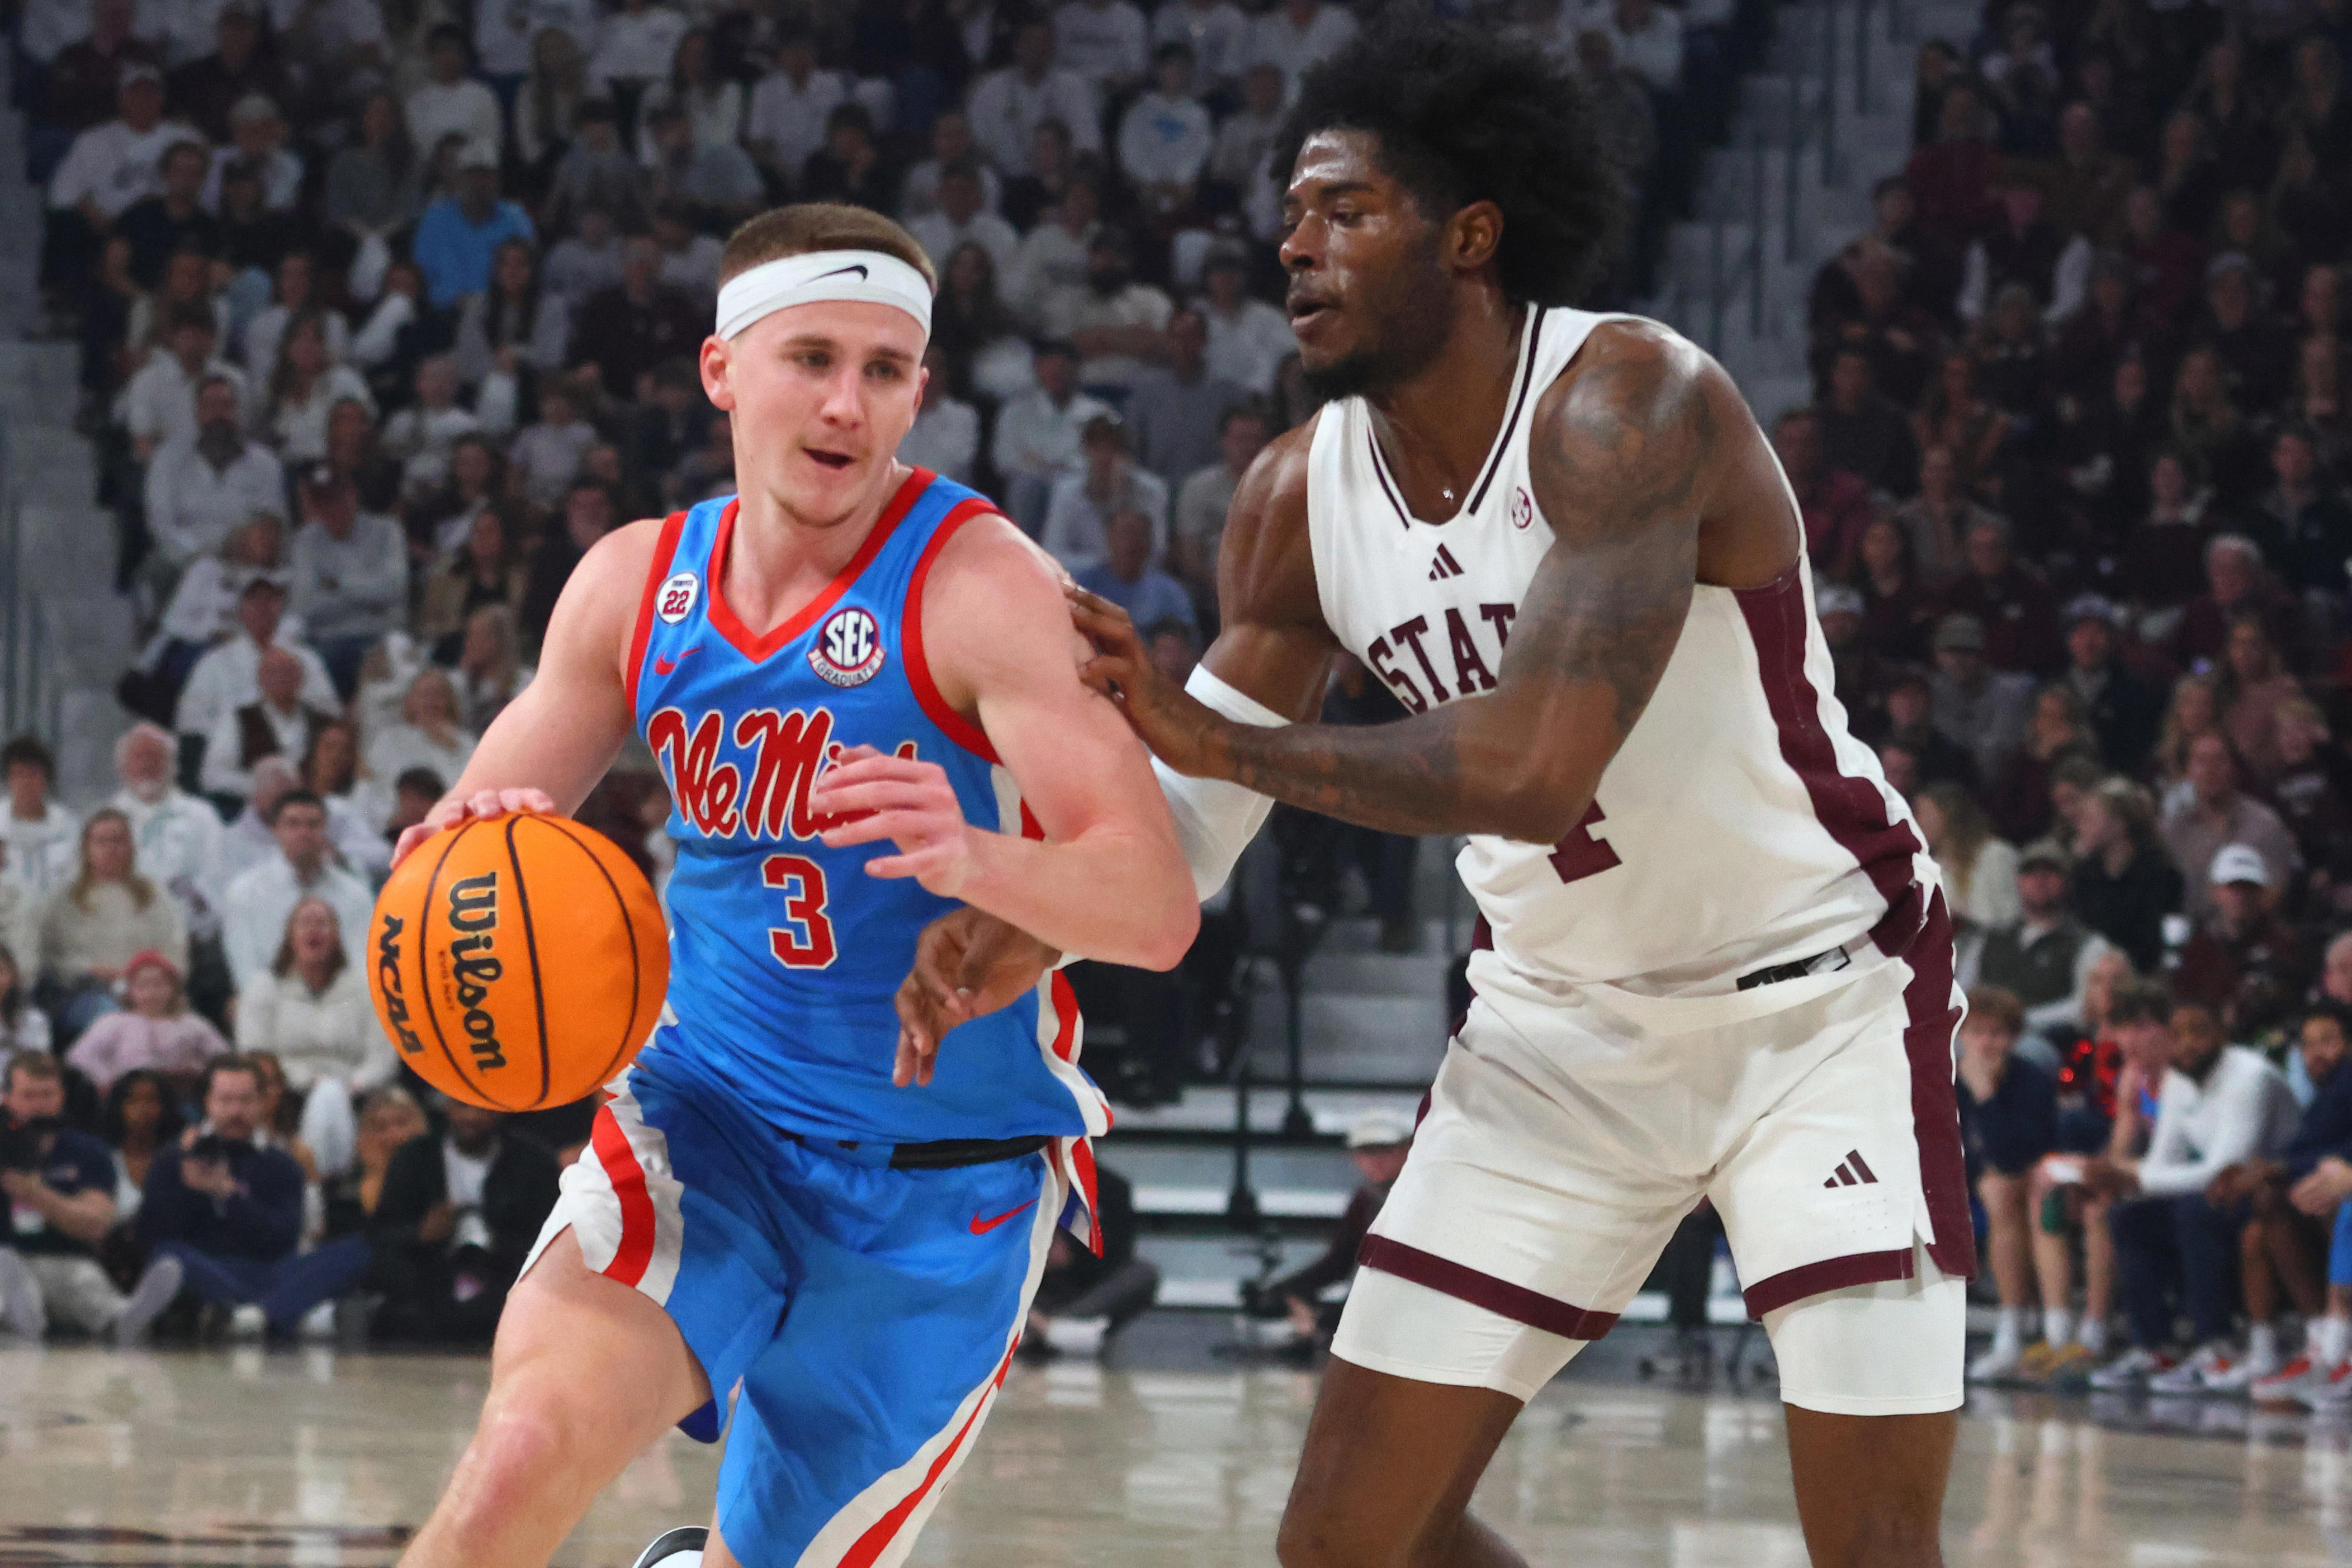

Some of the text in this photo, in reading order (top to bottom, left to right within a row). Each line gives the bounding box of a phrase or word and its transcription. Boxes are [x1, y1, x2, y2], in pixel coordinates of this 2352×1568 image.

[662, 590, 690, 614] 22
[825, 610, 874, 667] SEC
[1368, 603, 1516, 716] STAT
[646, 706, 918, 841] Ole Mi
[761, 854, 838, 970] 3
[378, 913, 425, 1054] NCAA
[448, 870, 508, 1074] Wilson
